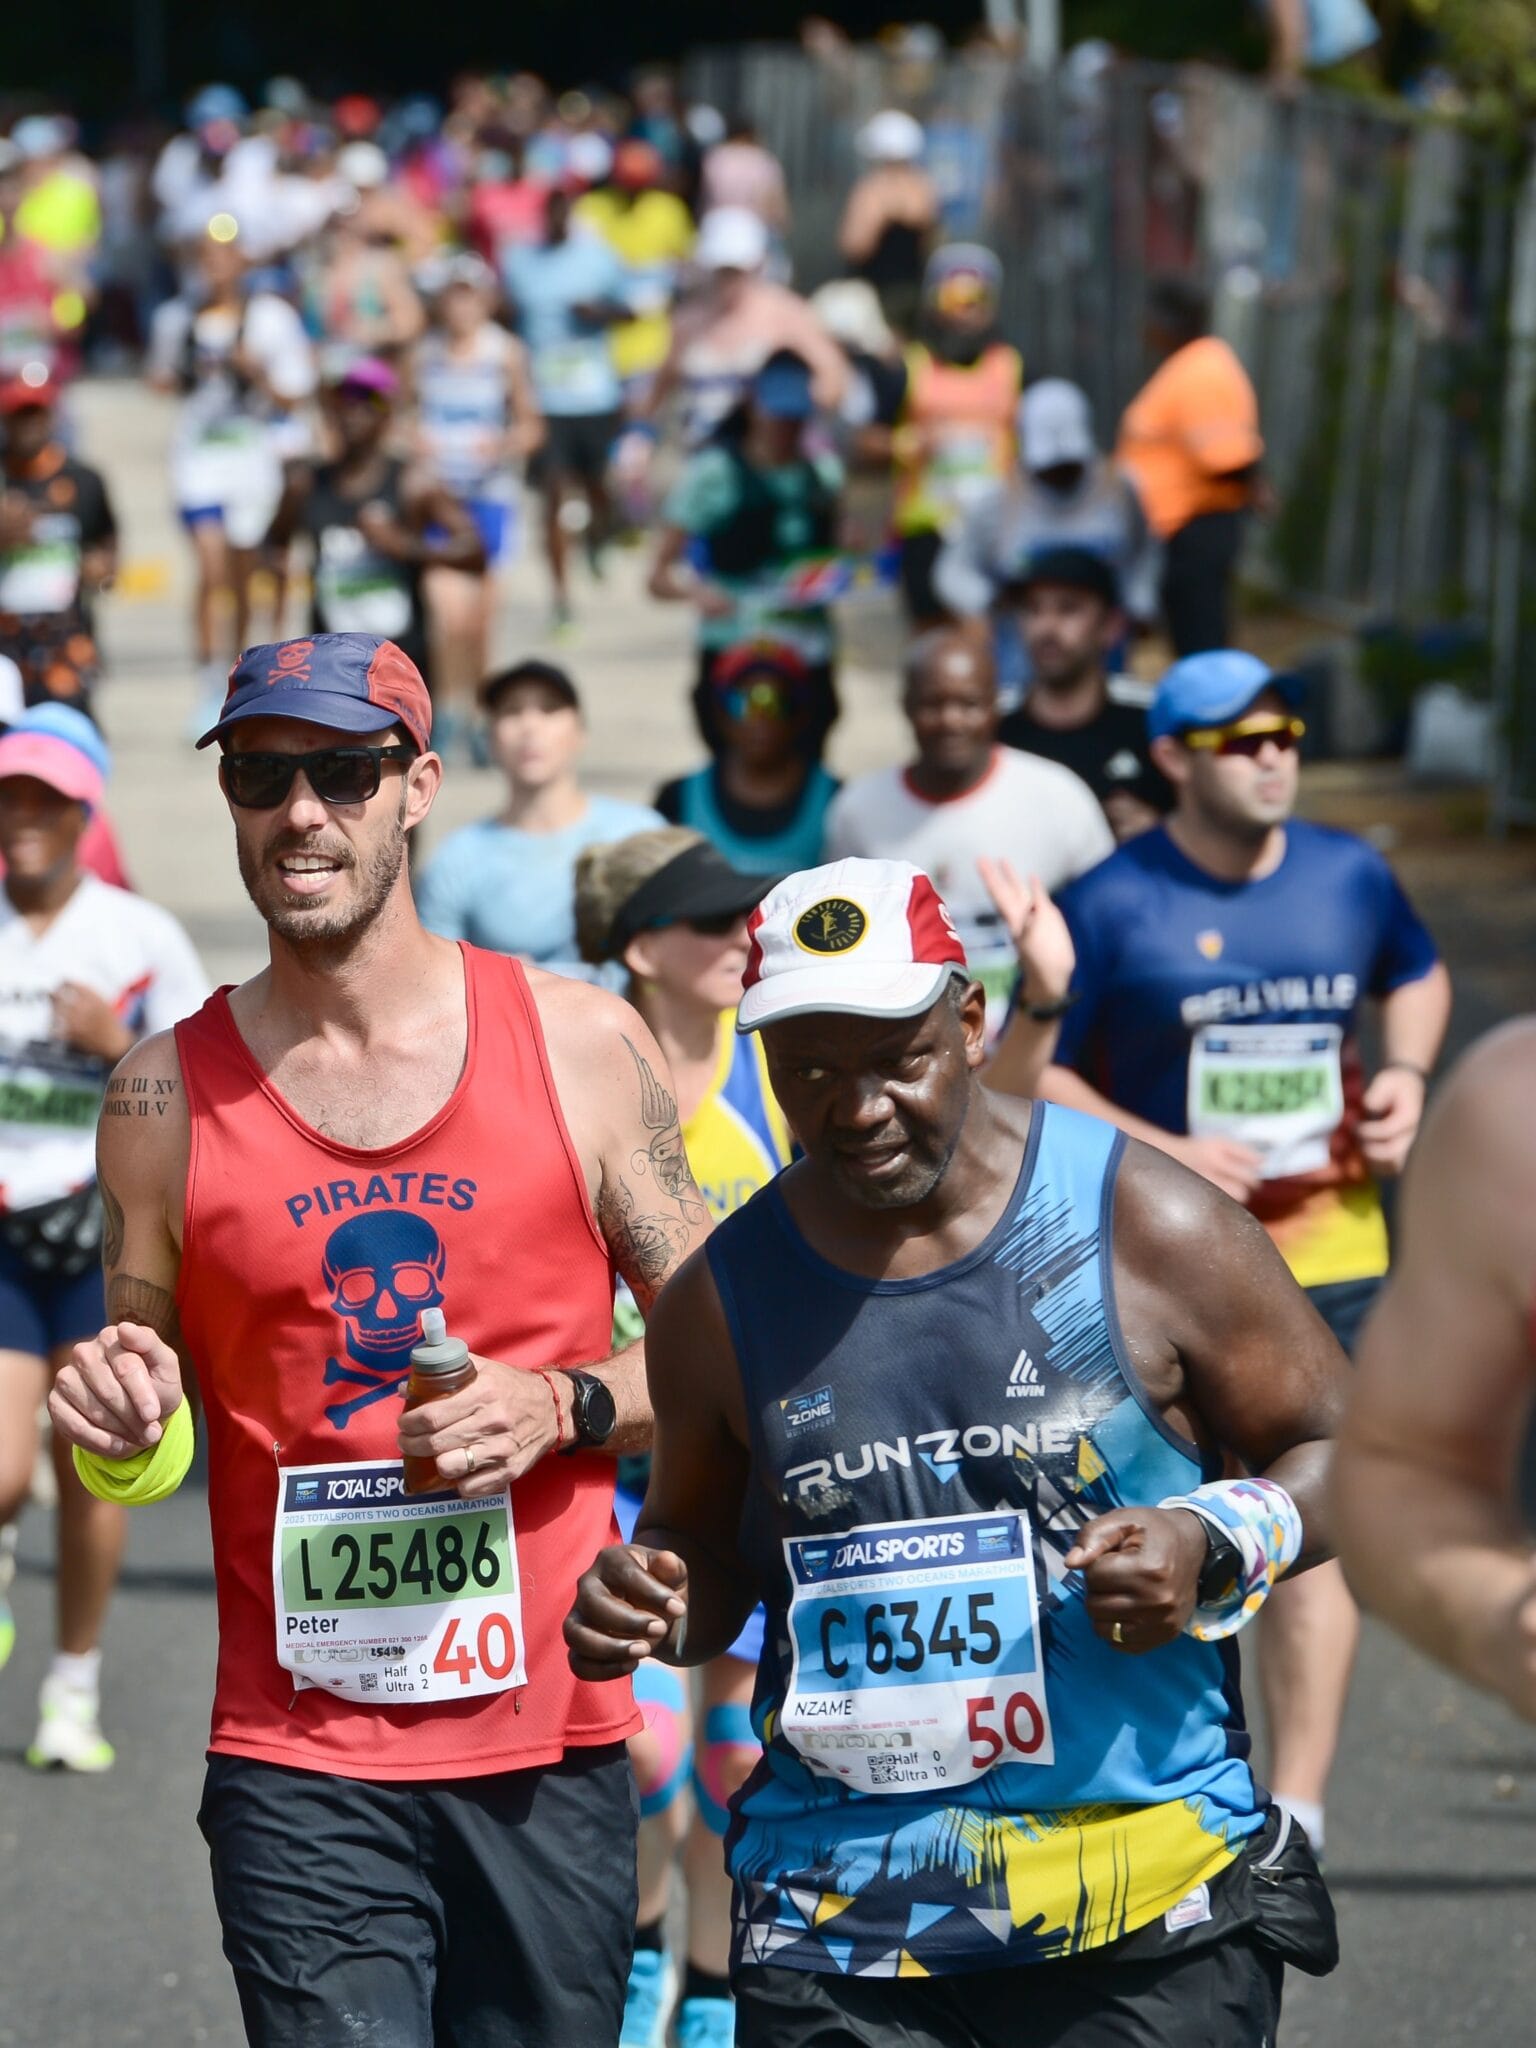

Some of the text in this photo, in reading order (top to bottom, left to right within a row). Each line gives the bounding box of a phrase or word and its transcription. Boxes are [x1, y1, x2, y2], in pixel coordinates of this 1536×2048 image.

[284, 1172, 478, 1228] PIRATES
[794, 1391, 829, 1411] RUN
[1006, 1385, 1046, 1398] KWIN
[787, 1402, 831, 1426] ZONE
[784, 1423, 1074, 1496] RUN ZONE
[285, 1497, 505, 1525] 2025 TOTALSPORTS TWO OCEANS MARATHON
[301, 1521, 500, 1601] L 25486
[879, 1577, 904, 1587] TWO
[907, 1568, 956, 1584] OCEANS
[959, 1563, 1025, 1578] MARATHON
[286, 1616, 339, 1635] Peter
[819, 1592, 1002, 1679] C 6345
[286, 1641, 314, 1649] MEDICAL
[316, 1638, 358, 1647] EMERGENCY
[359, 1637, 387, 1645] NUMBER
[433, 1612, 516, 1685] 40
[384, 1663, 427, 1677] Half 0
[385, 1678, 429, 1693] Ultra 2
[794, 1699, 853, 1717] NZAME
[966, 1691, 1045, 1769] 50
[895, 1750, 941, 1765] Half 0
[895, 1766, 947, 1782] Ultra 10
